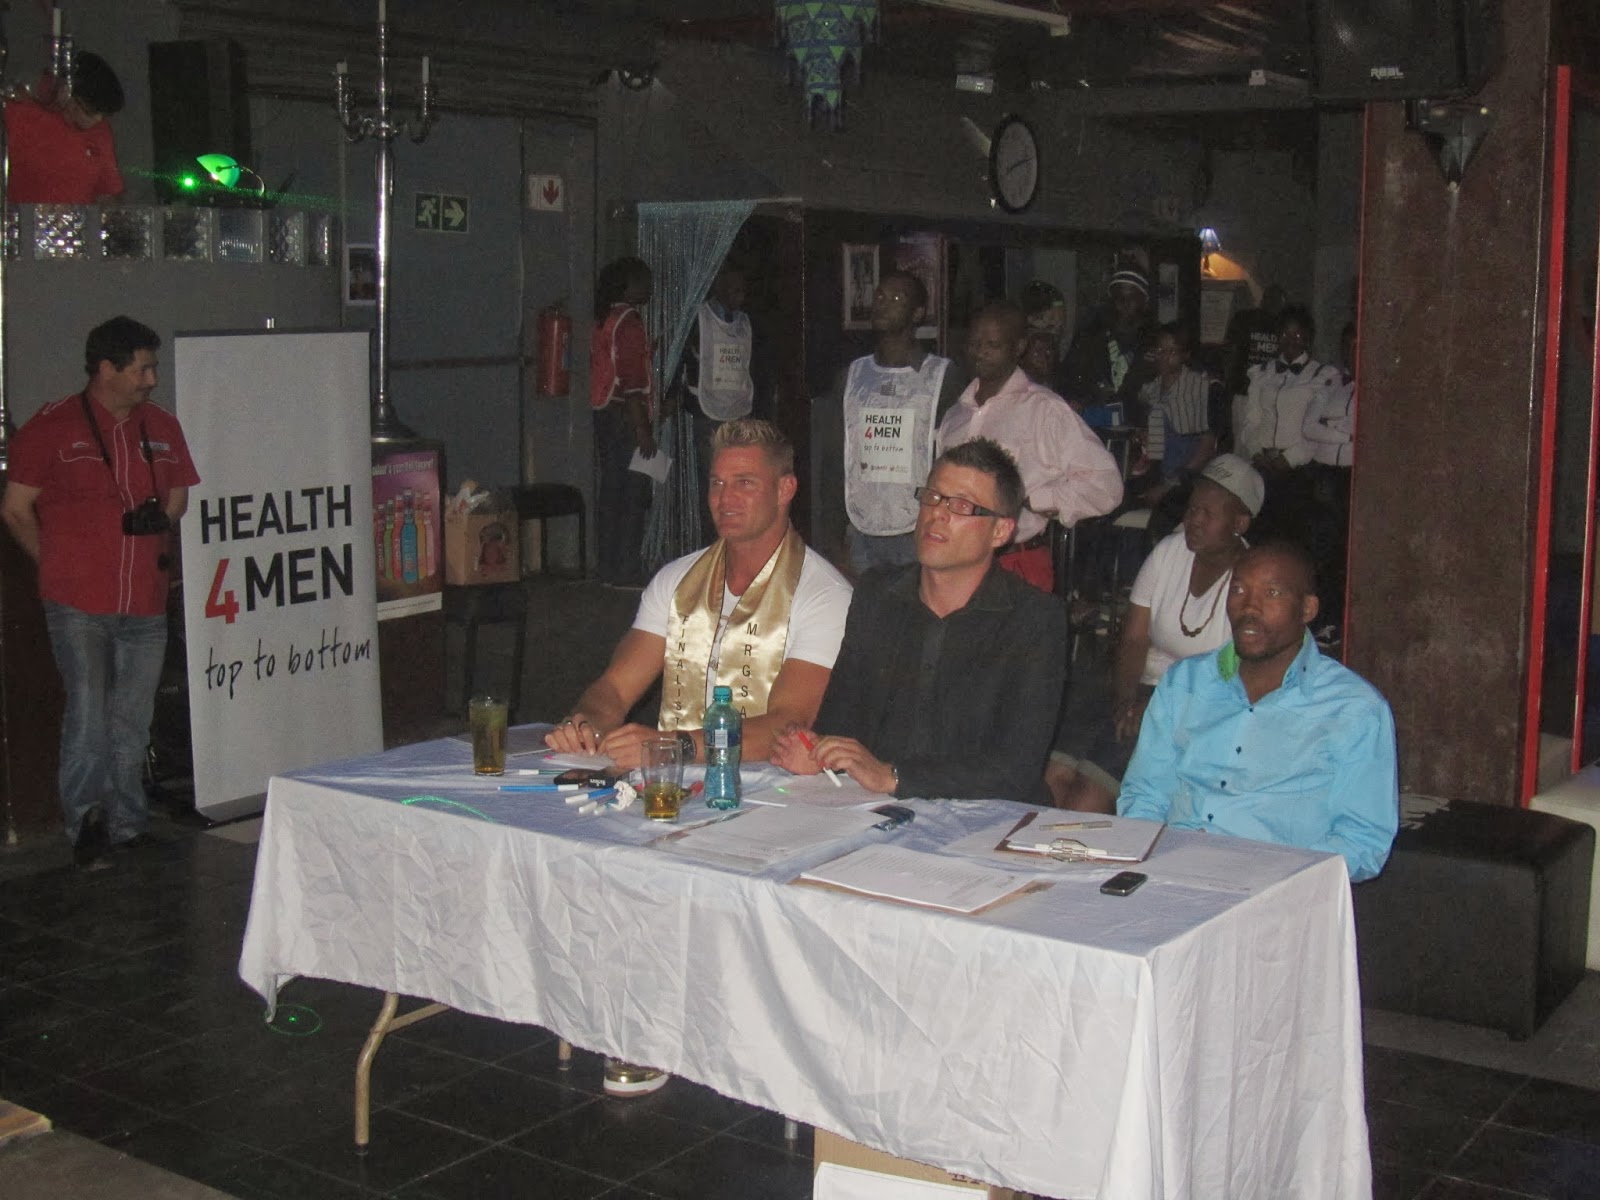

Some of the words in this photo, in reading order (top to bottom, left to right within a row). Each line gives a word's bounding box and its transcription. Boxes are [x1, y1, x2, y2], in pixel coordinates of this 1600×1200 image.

[864, 426, 901, 440] 4MEN
[865, 414, 902, 425] HEALTH
[200, 484, 352, 544] HEALTH
[205, 543, 354, 625] 4MEN
[205, 646, 243, 700] top
[253, 638, 276, 681] to
[287, 626, 371, 675] bottom
